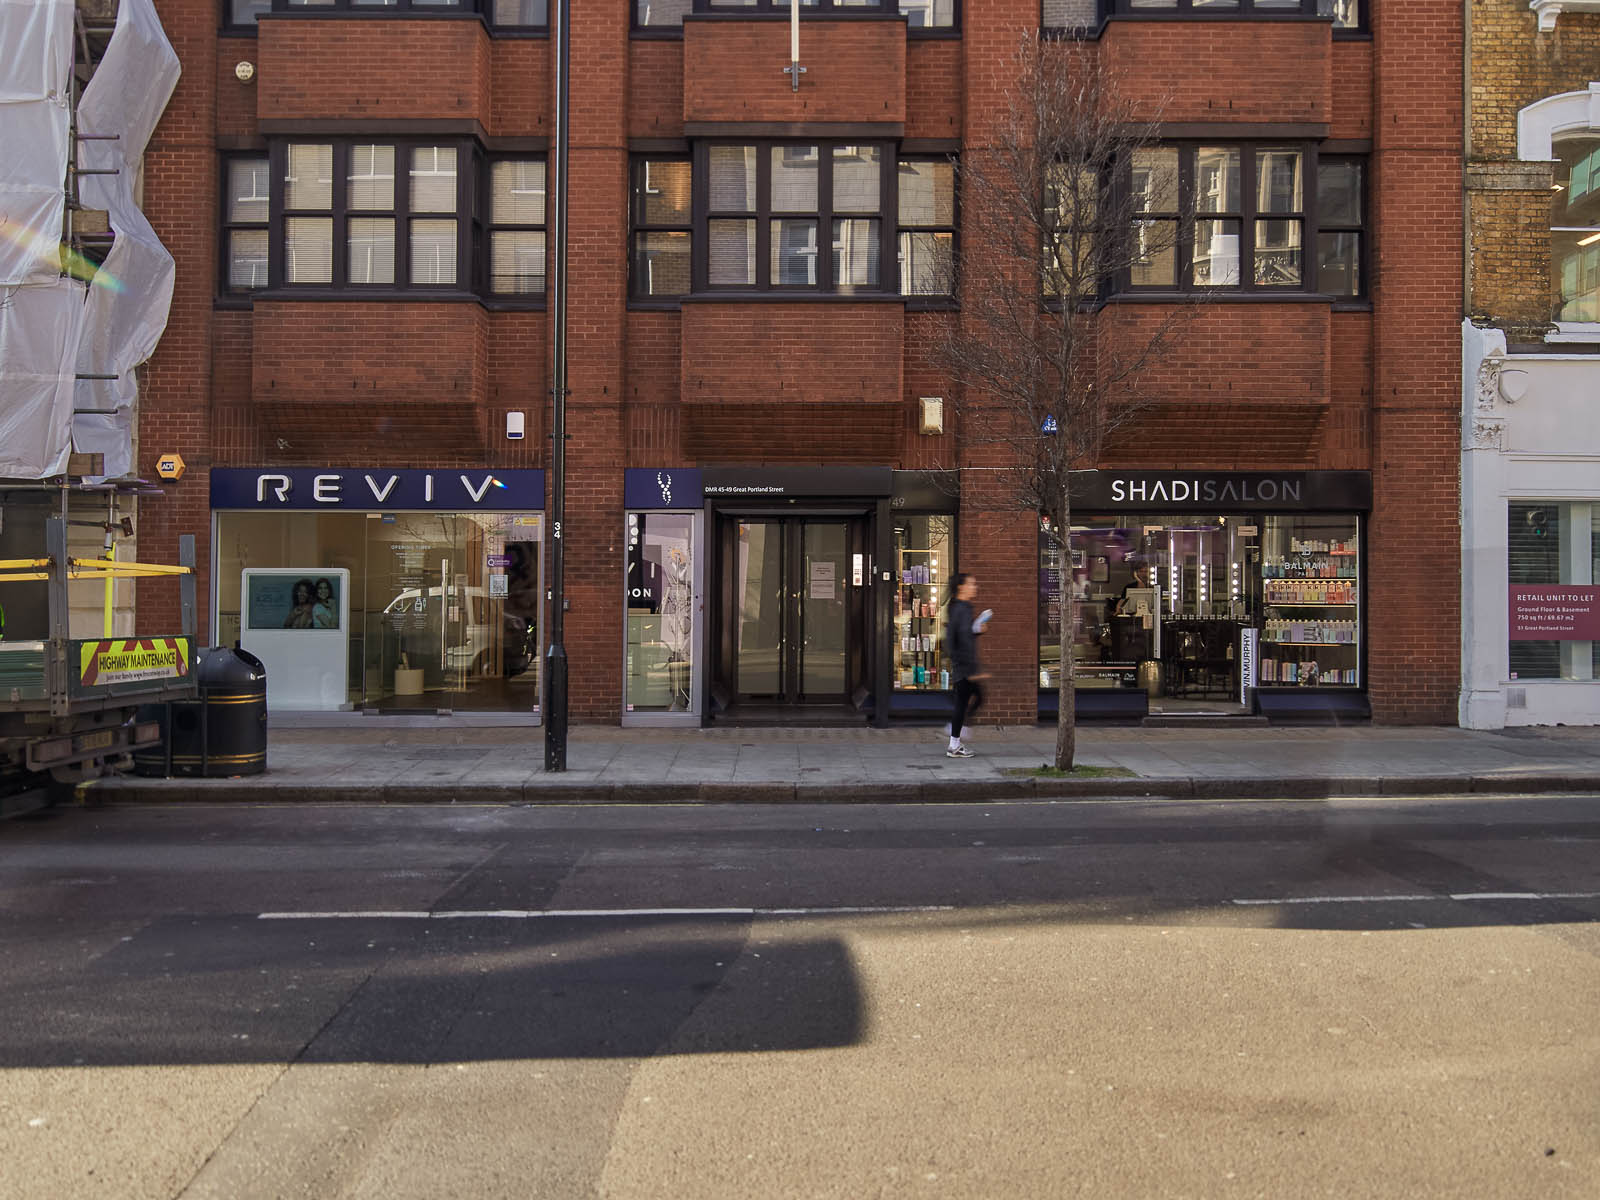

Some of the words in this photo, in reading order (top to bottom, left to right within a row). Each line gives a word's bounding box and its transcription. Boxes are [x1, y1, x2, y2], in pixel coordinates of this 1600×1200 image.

[256, 474, 495, 502] REVIV
[1284, 562, 1329, 570] BALMAIN
[1517, 594, 1545, 602] RETAIL
[1546, 594, 1566, 602] UNIT
[1567, 594, 1579, 602] TO
[1580, 594, 1595, 602] LET
[99, 655, 129, 670] HIGHWAY
[131, 652, 176, 667] MAINTENANCE
